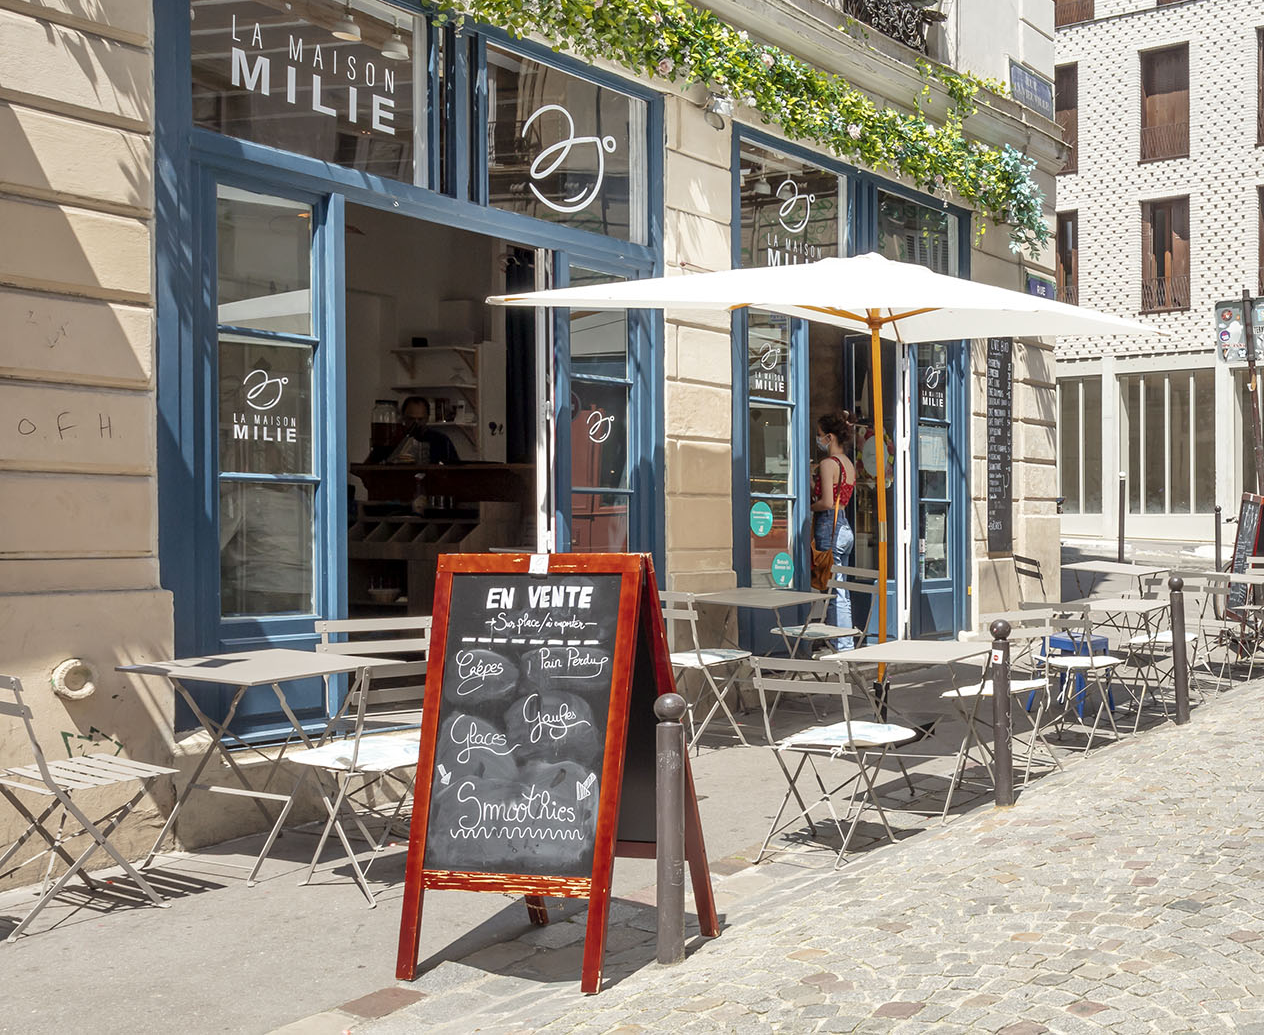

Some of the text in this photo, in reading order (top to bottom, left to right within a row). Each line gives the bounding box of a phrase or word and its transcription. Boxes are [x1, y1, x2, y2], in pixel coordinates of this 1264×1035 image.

[231, 14, 395, 95] LA MAISON
[231, 46, 396, 135] MILIE
[768, 233, 822, 259] LA MAISON
[755, 379, 785, 393] MILIE
[764, 372, 785, 382] MAISON
[922, 396, 944, 407] MILIE
[233, 412, 296, 427] LA MAISON
[233, 424, 297, 443] MILIE
[486, 586, 594, 609] EN VENTE
[494, 612, 516, 631] Sur
[539, 647, 562, 670] Pain
[450, 714, 514, 762] Glaces
[457, 781, 576, 830] Smoothies
